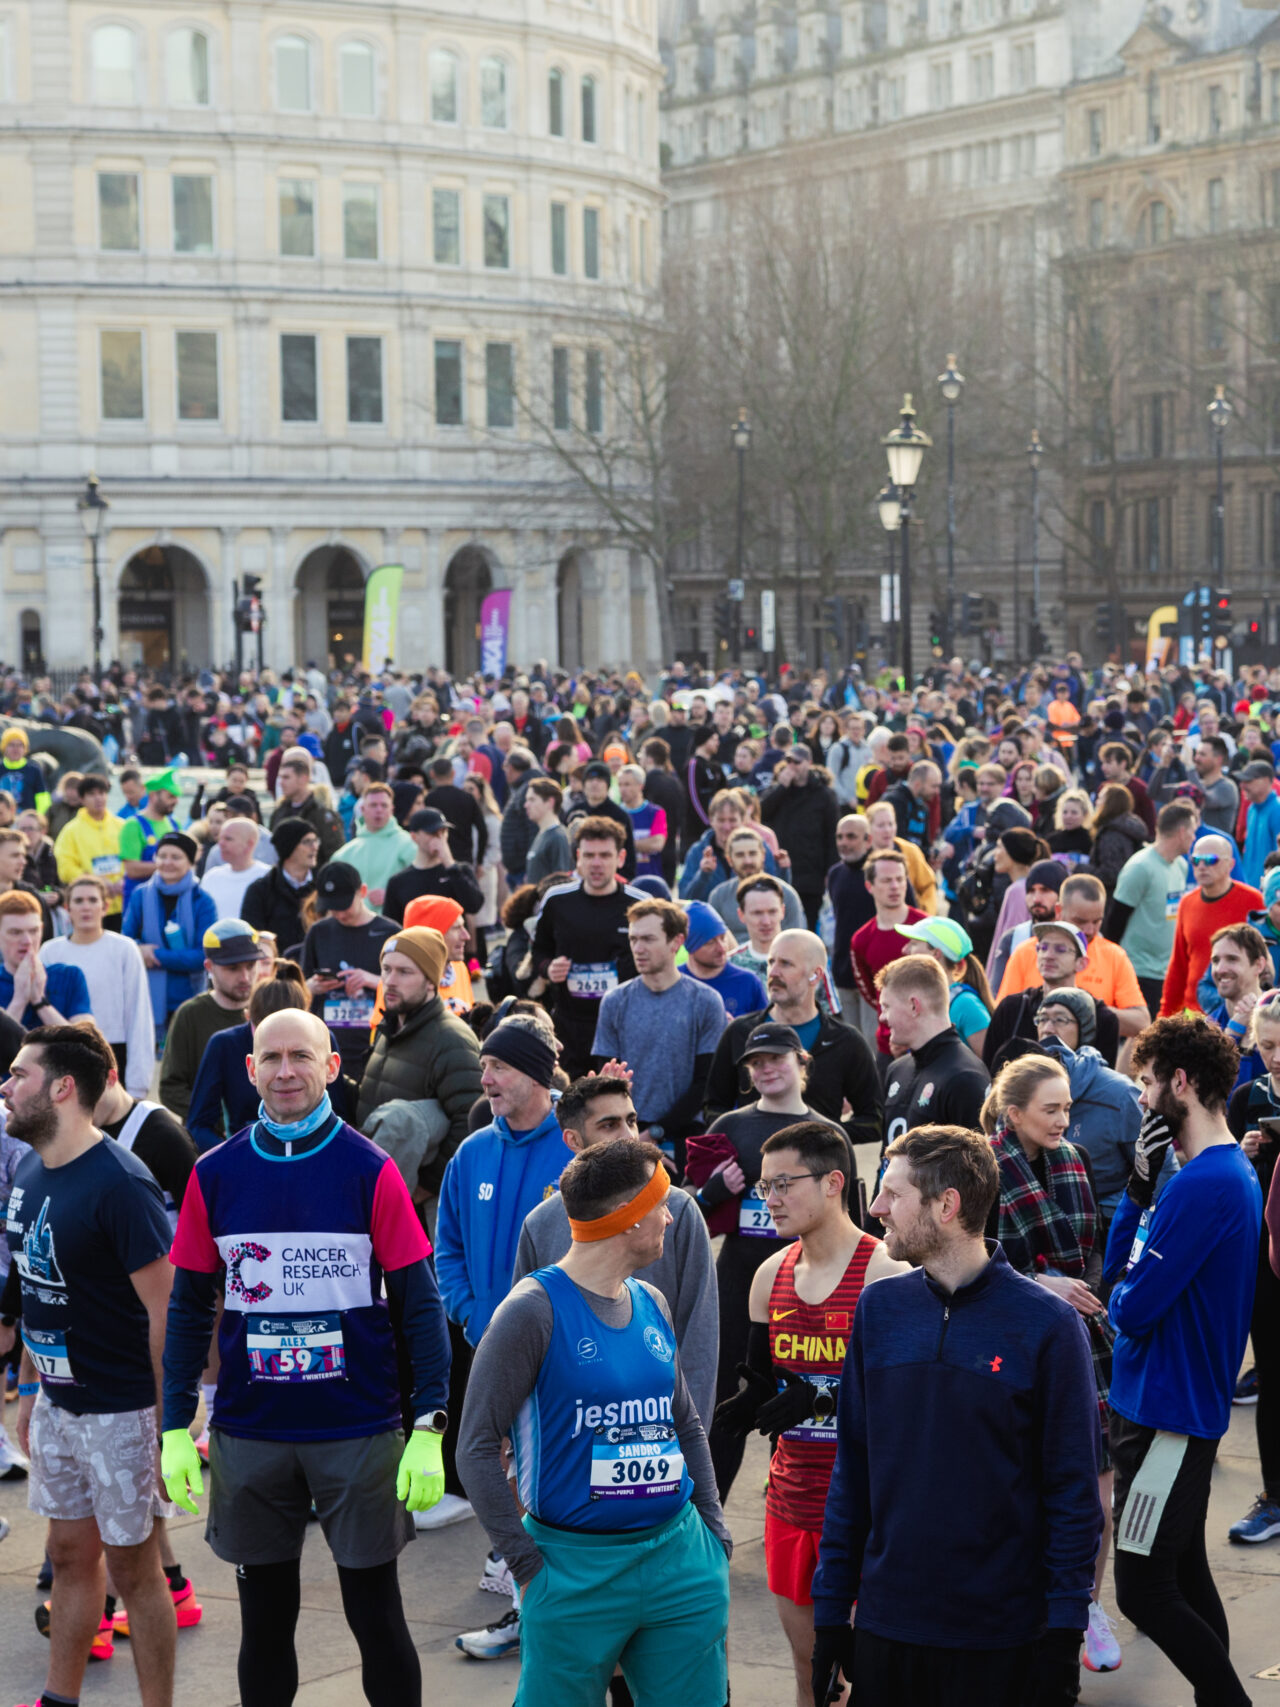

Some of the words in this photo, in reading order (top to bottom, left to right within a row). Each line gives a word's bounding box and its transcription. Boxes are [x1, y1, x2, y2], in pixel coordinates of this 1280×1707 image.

[478, 1182, 494, 1201] SD
[282, 1248, 347, 1262] CANCER
[283, 1264, 361, 1279] RESEARCH
[283, 1282, 305, 1296] UK
[280, 1337, 307, 1347] ALEX
[774, 1333, 847, 1362] CHINA
[280, 1349, 312, 1372] 59
[618, 1443, 661, 1458] SANDRO
[612, 1458, 670, 1484] 3069
